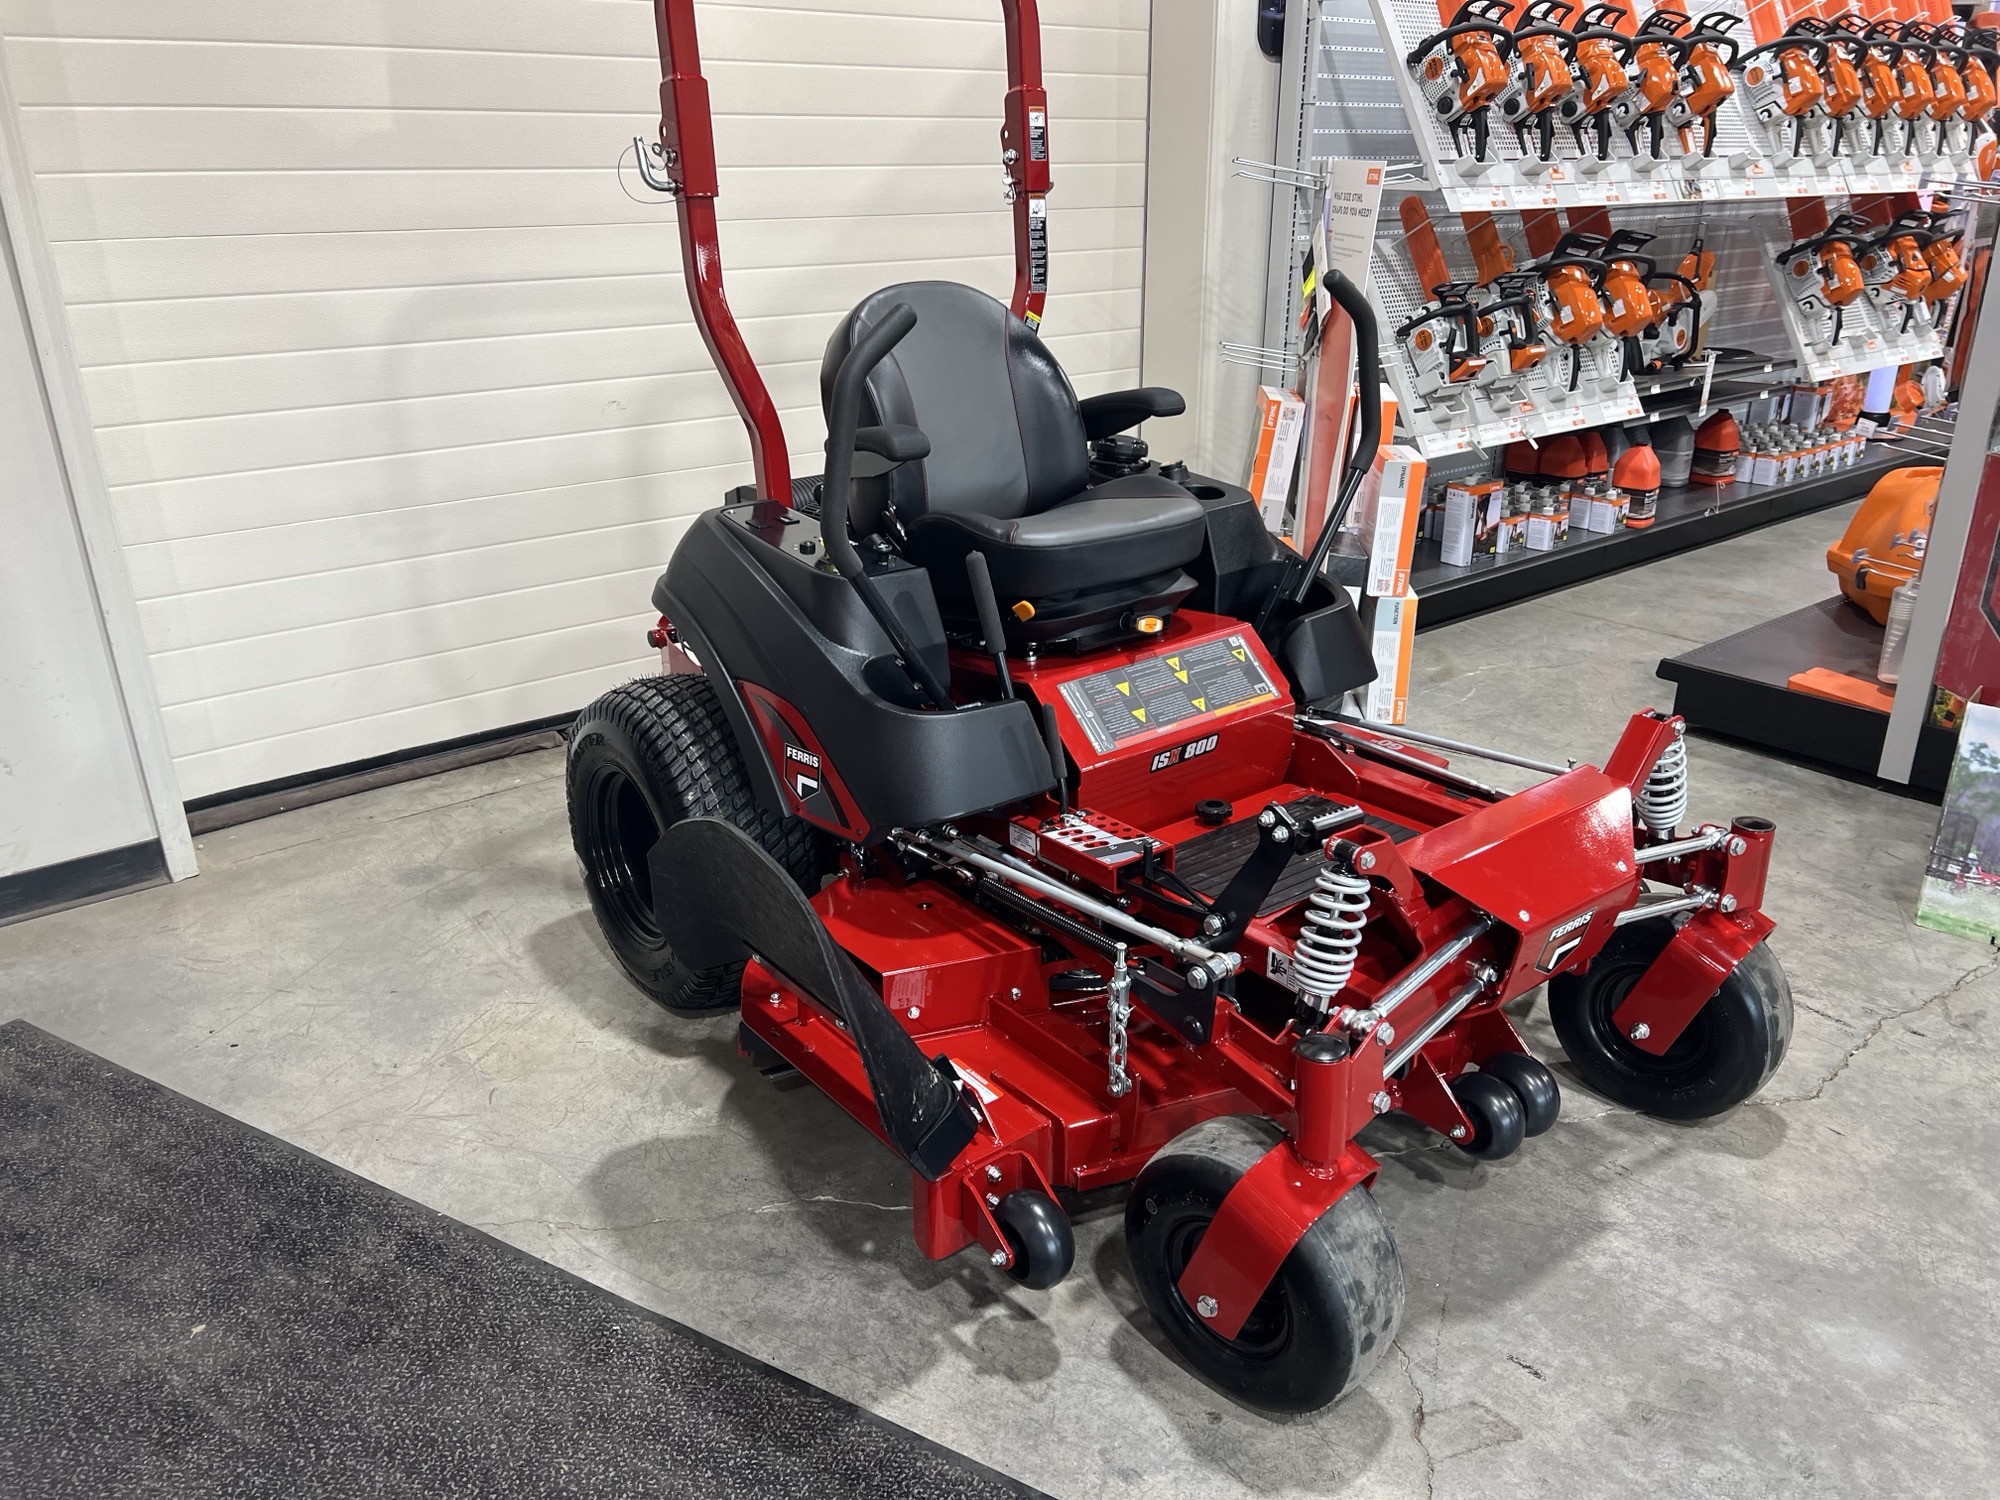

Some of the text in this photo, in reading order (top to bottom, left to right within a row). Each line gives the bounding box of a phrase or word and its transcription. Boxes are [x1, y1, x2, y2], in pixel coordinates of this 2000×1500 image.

[1334, 191, 1363, 203] WHAT SIZE STIHL
[1332, 205, 1343, 215] CHAPS
[1343, 206, 1349, 216] DO
[1350, 207, 1358, 217] YOU
[1267, 404, 1277, 427] STIHL
[1398, 465, 1407, 489] DYNAMIC
[1396, 572, 1405, 596] STIHL
[1392, 601, 1400, 625] FUNCTION
[1396, 700, 1404, 721] STIHL
[786, 746, 819, 768] FERRIS
[1151, 735, 1218, 771] ISX 800
[1549, 911, 1593, 942] FERRIS
